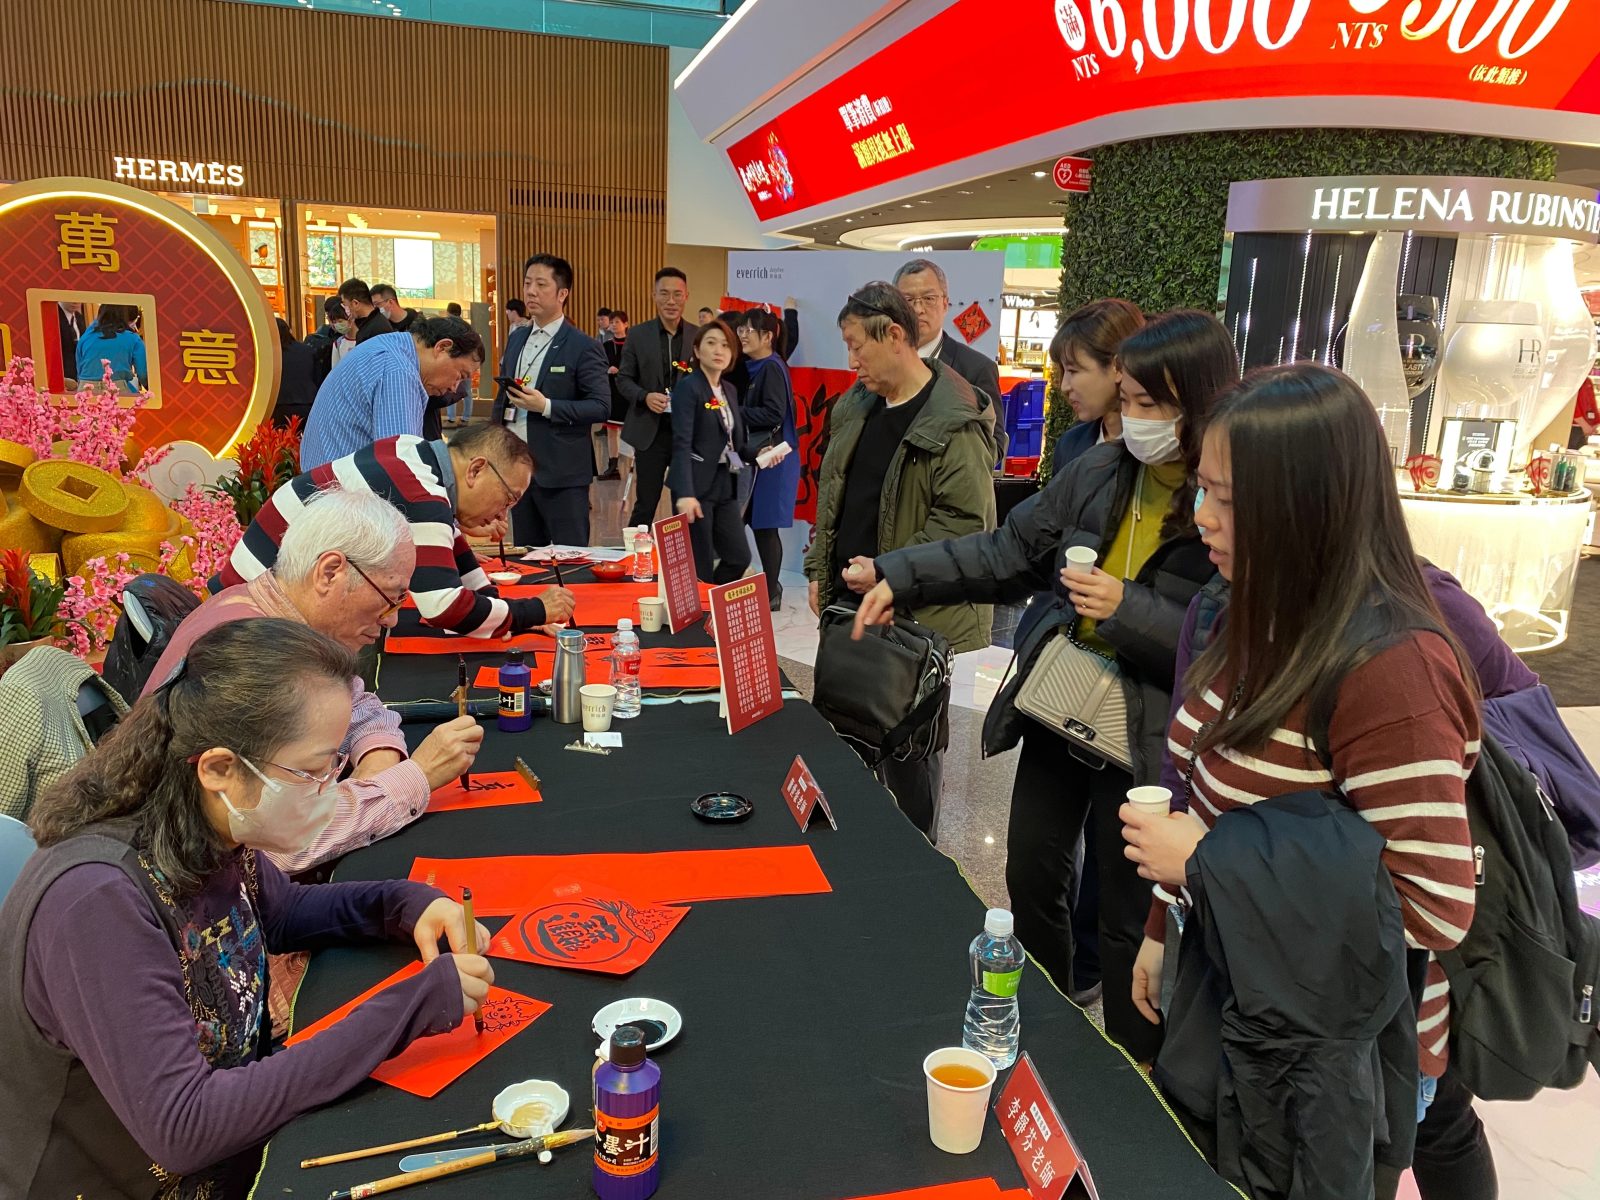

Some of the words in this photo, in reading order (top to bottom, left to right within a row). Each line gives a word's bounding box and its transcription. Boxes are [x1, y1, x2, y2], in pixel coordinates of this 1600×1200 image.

[1058, 3, 1083, 42] 滿
[1311, 187, 1474, 222] HELENA
[54, 211, 121, 273] 萬
[736, 266, 768, 279] everrich
[1004, 294, 1035, 308] Whoo
[179, 328, 240, 385] 意
[596, 1125, 650, 1156] 墨汁
[1007, 1096, 1056, 1189] 李靜芬老師
